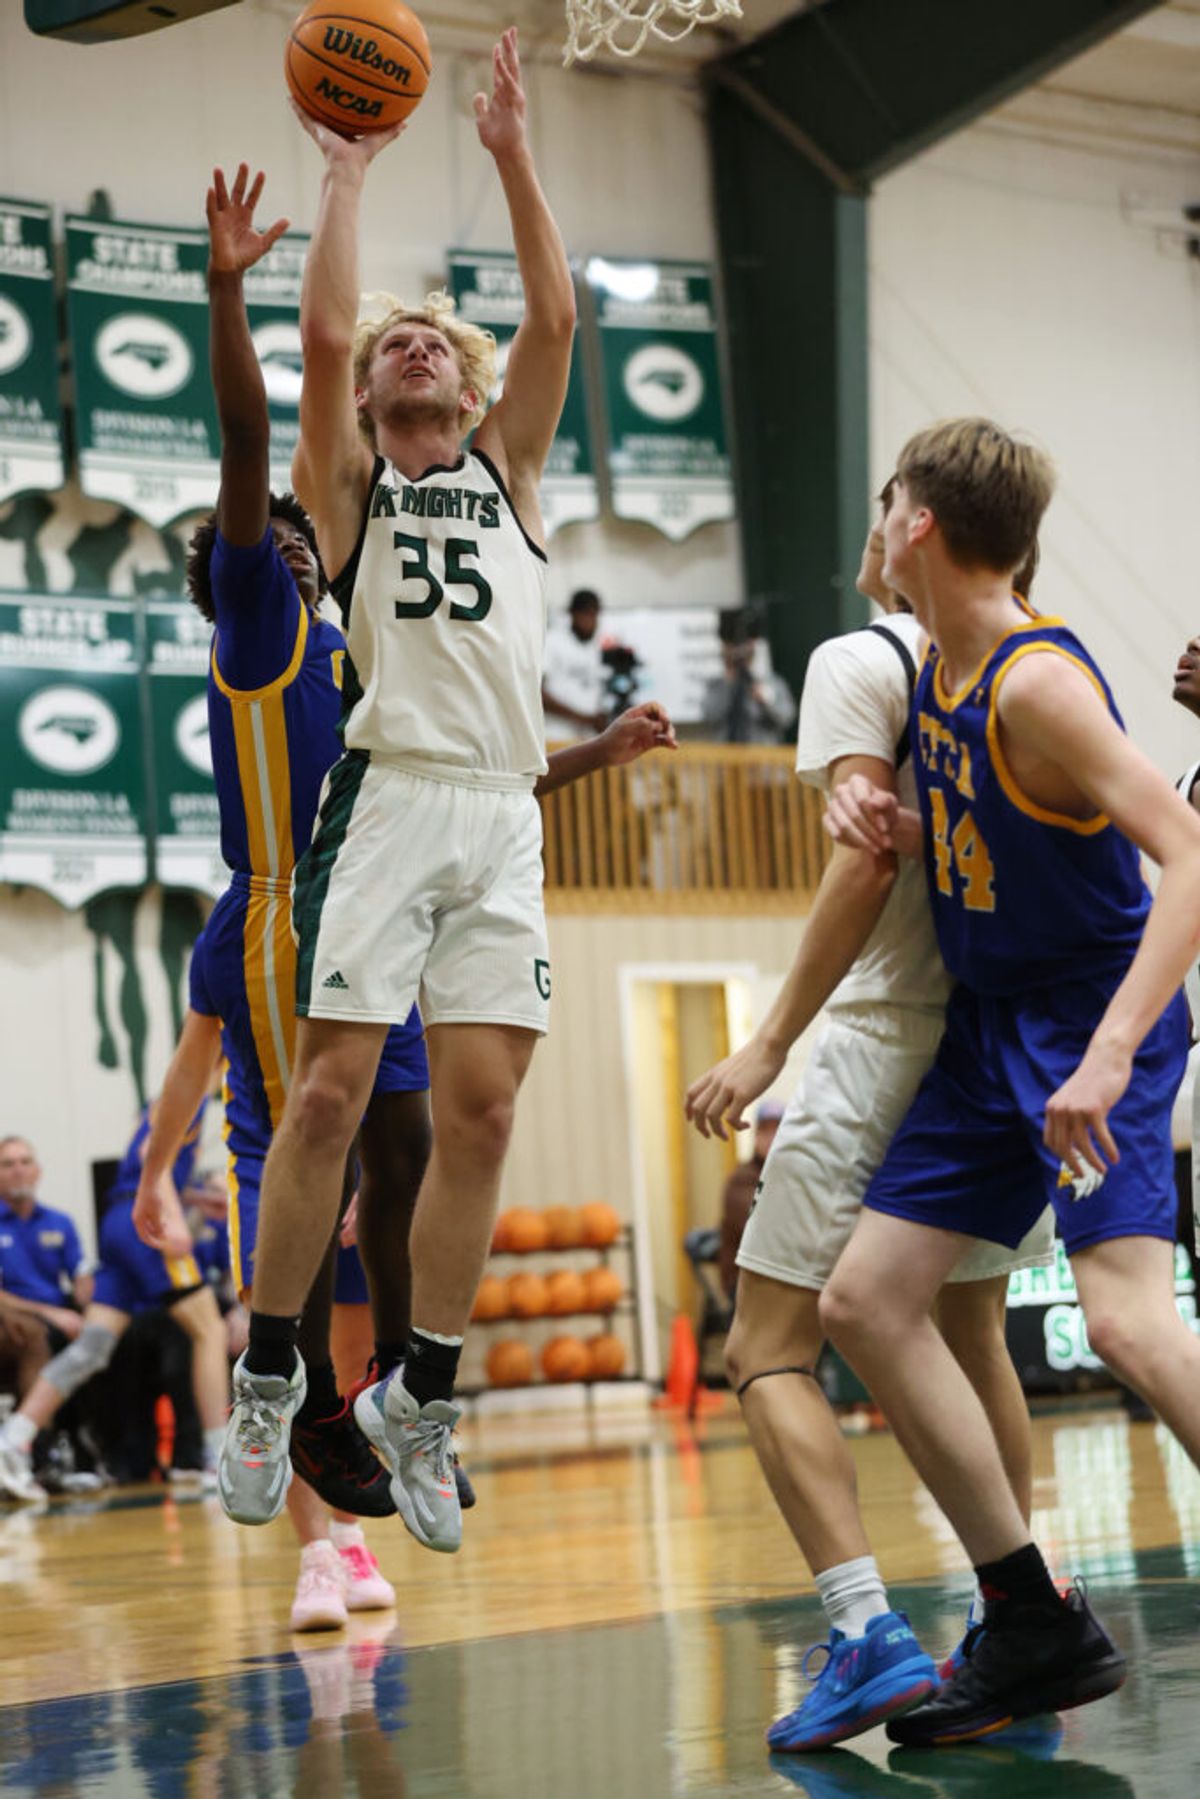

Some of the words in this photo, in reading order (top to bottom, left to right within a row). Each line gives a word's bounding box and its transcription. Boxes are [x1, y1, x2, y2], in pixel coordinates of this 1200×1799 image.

[323, 26, 411, 86] Wilson
[315, 77, 383, 118] NCAA
[94, 234, 178, 273] STATE
[394, 531, 493, 621] 35
